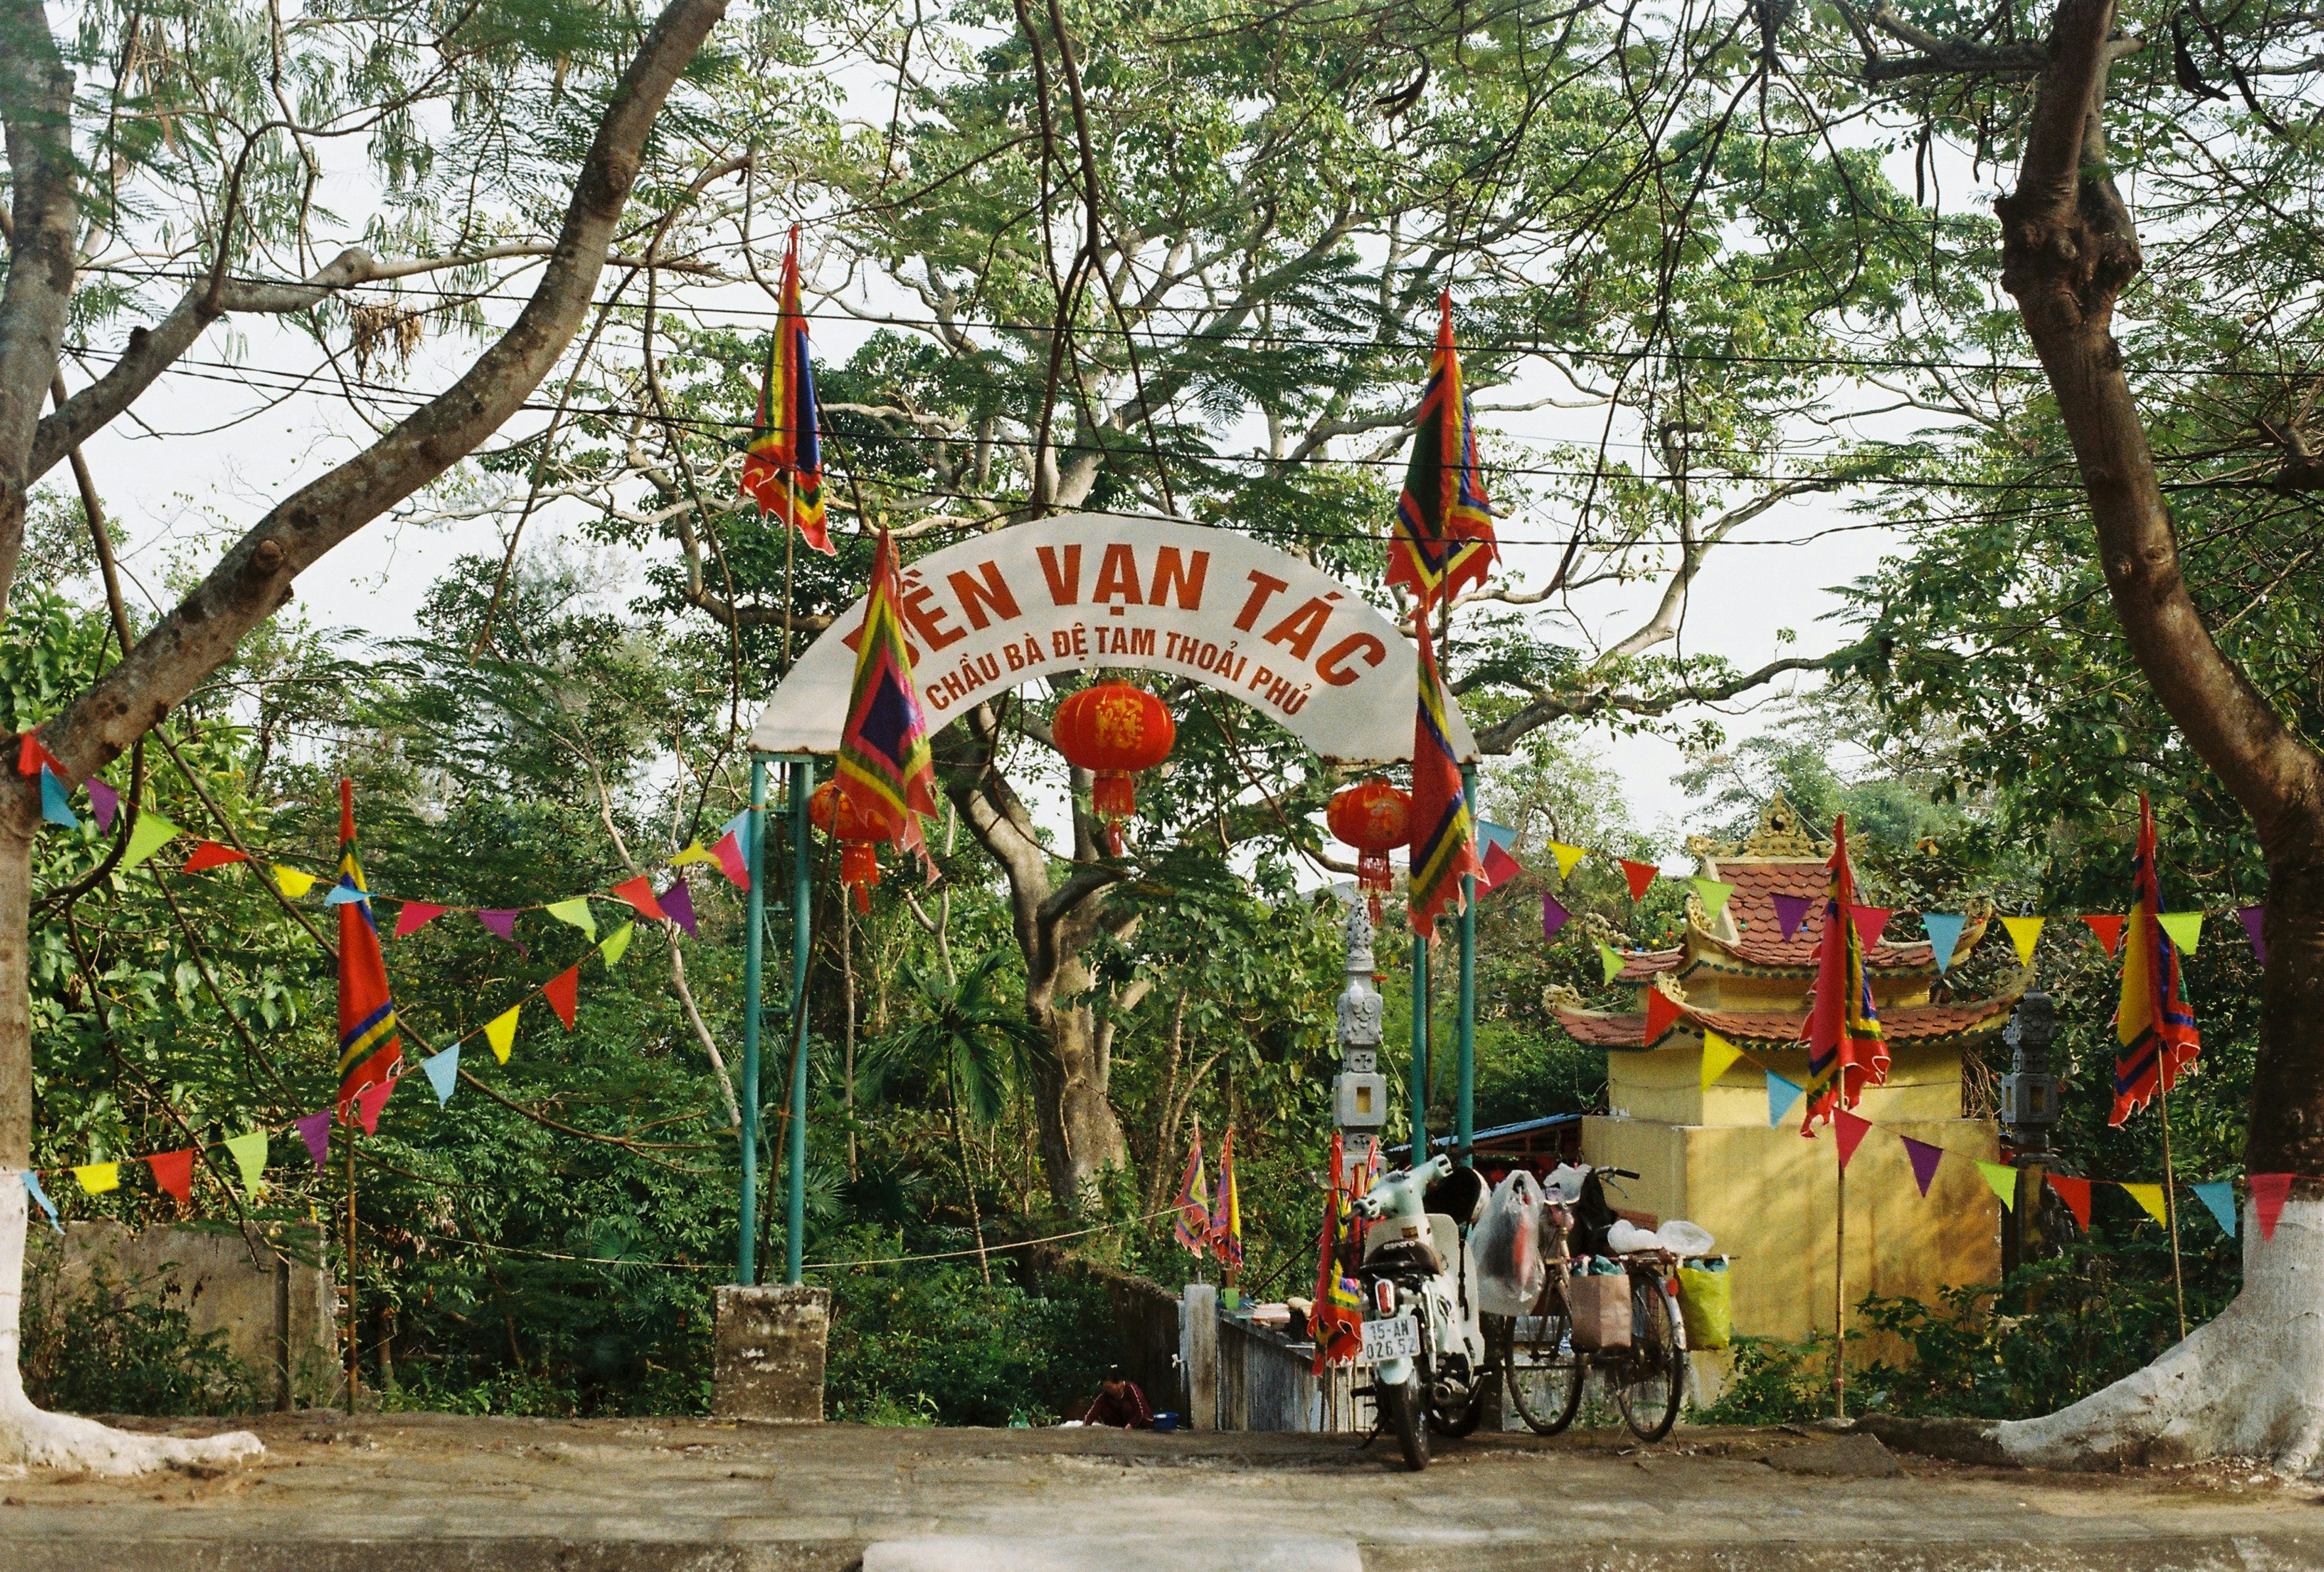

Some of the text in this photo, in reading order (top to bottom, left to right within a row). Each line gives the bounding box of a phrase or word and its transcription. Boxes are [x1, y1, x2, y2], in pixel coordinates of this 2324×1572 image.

[1036, 544, 1210, 616] VẠN
[1233, 570, 1386, 686] TÁC
[926, 622, 1312, 715] CHẦU BÀ ĐỆ TAM THOẢI PHỦ
[1370, 1320, 1409, 1340] 15-AN
